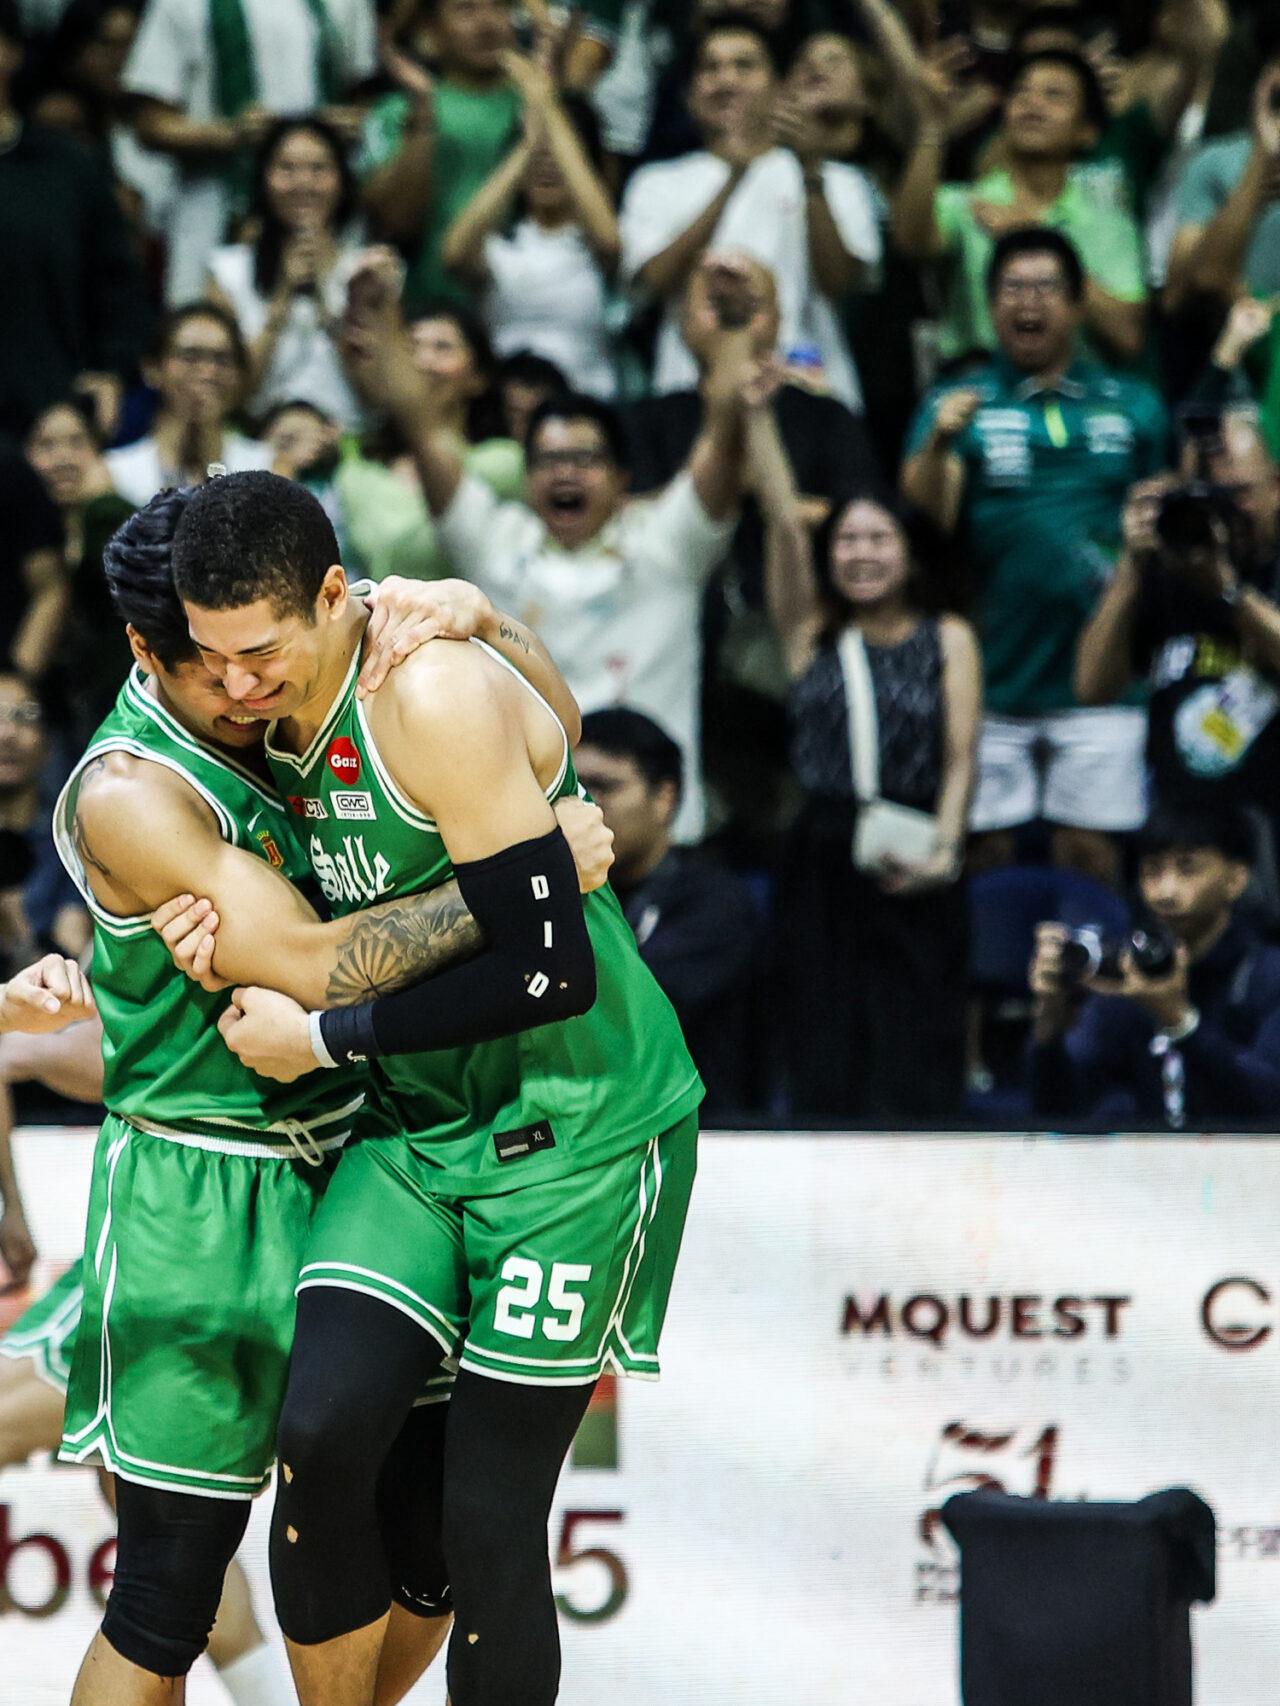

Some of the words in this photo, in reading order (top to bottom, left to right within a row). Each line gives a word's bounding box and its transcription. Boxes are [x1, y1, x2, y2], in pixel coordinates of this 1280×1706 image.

[340, 797, 367, 808] CWC
[310, 833, 395, 903] Salle
[532, 1130, 545, 1142] XL
[493, 1256, 592, 1342] 25
[840, 1292, 1134, 1350] MQUEST
